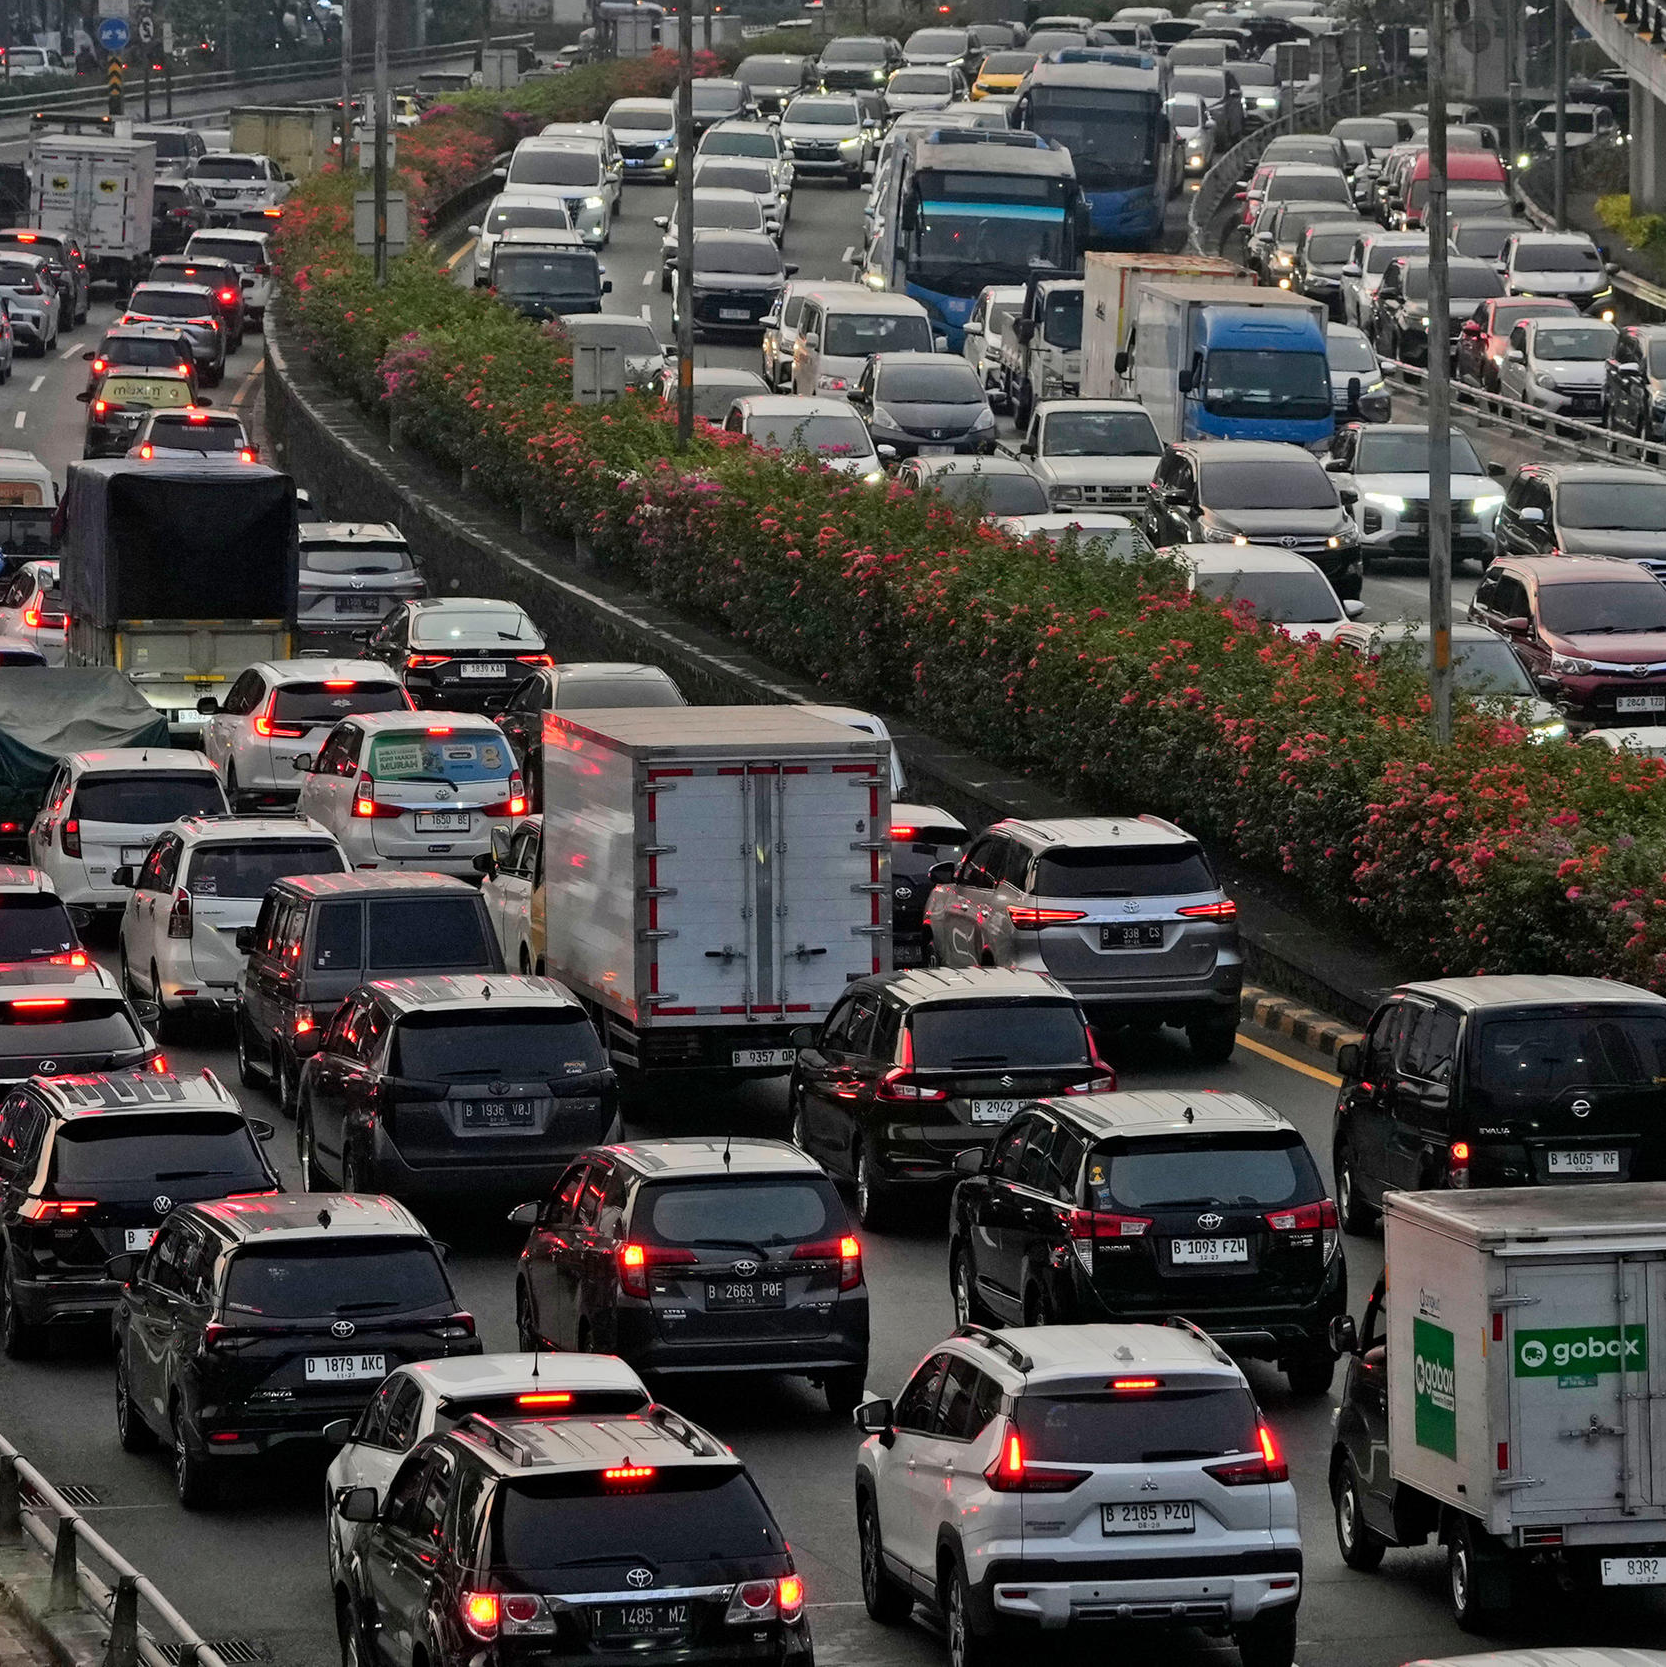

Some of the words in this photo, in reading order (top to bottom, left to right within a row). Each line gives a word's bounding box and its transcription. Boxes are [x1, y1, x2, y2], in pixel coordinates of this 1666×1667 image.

[380, 761, 418, 771] MURAH
[1122, 928, 1140, 939] 338
[1148, 927, 1160, 938] CS
[734, 1053, 740, 1064] B
[749, 1051, 774, 1063] 9357
[465, 1105, 472, 1116] B
[481, 1104, 505, 1116] 1936
[973, 1102, 981, 1113] B
[987, 1101, 1013, 1112] 2942
[1551, 1154, 1558, 1165] B
[1566, 1153, 1593, 1164] 1605
[1603, 1153, 1616, 1164] RF
[128, 1232, 135, 1243] B
[1174, 1242, 1181, 1254] B
[1188, 1241, 1216, 1253] 1093
[708, 1286, 715, 1298] B
[725, 1285, 753, 1297] 2663
[1553, 1338, 1640, 1367] gobox
[307, 1359, 314, 1372] D
[324, 1358, 353, 1371] 1879
[361, 1357, 383, 1370] AKC
[1425, 1356, 1454, 1396] gobox
[1106, 1509, 1114, 1522] B
[1122, 1507, 1157, 1521] 2185
[1604, 1562, 1611, 1575] F
[1627, 1561, 1658, 1575] 8382
[593, 1610, 602, 1626] T
[620, 1607, 654, 1625] 1485
[667, 1606, 686, 1623] MZ
